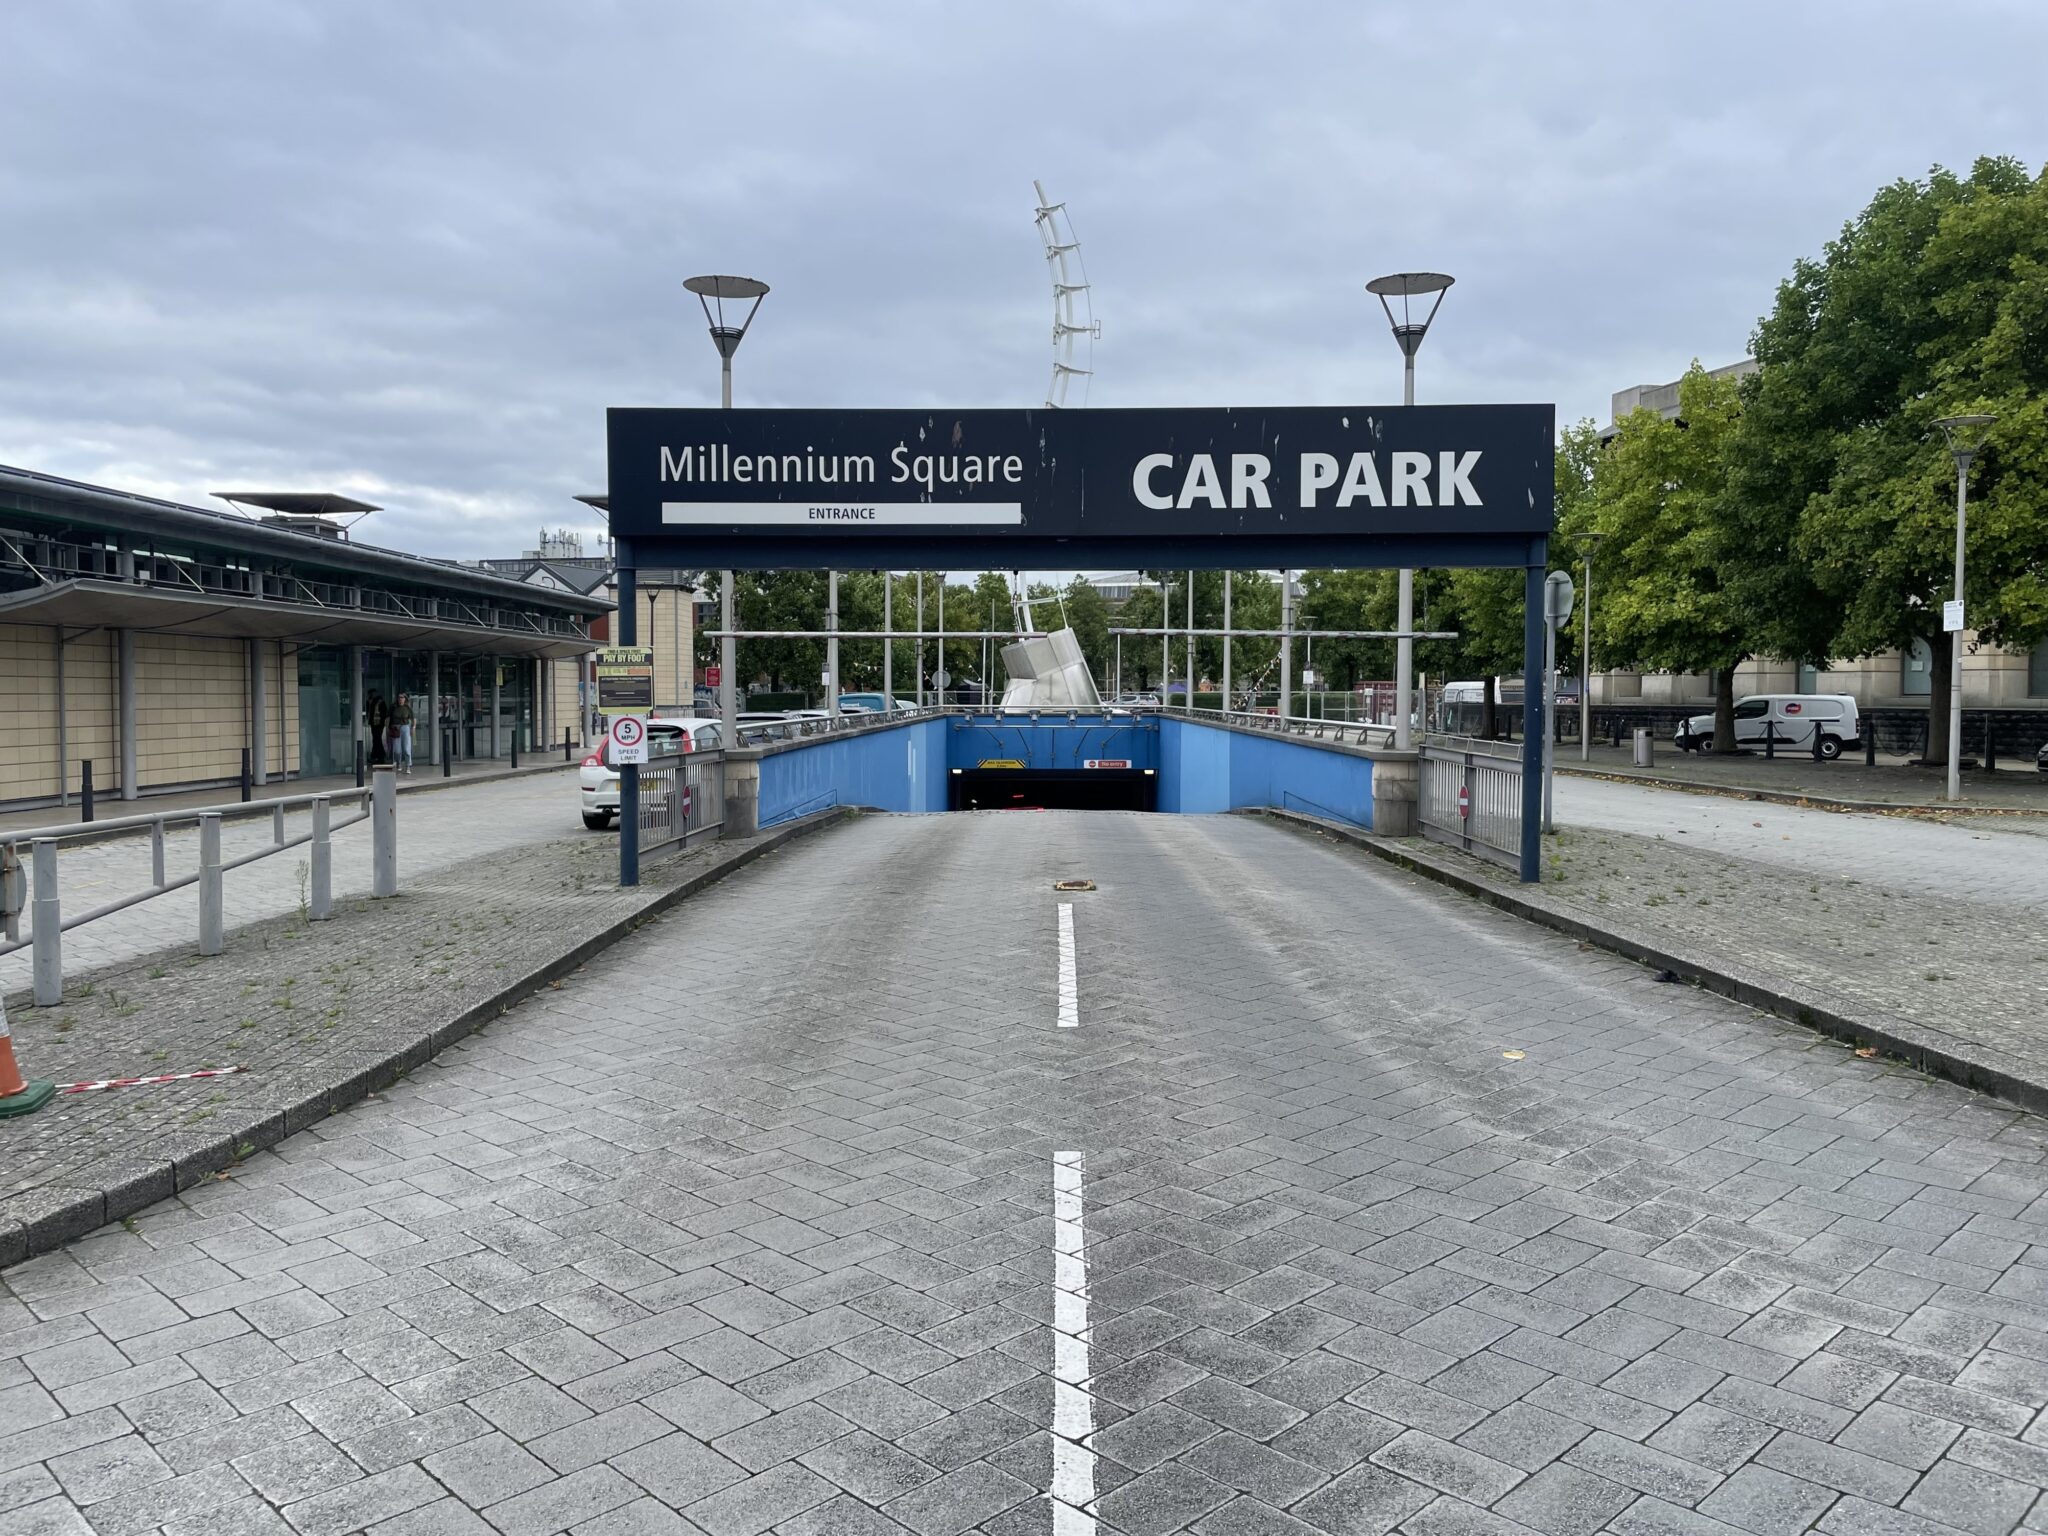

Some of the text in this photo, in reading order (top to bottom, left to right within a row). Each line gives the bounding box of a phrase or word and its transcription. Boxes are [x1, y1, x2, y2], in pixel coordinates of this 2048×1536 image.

[660, 444, 1023, 492] Millennium Square
[1132, 450, 1484, 510] CAR PARK
[808, 508, 875, 520] ENTRANCE
[603, 654, 645, 663] PAY BY FOOT
[624, 723, 632, 734] 5
